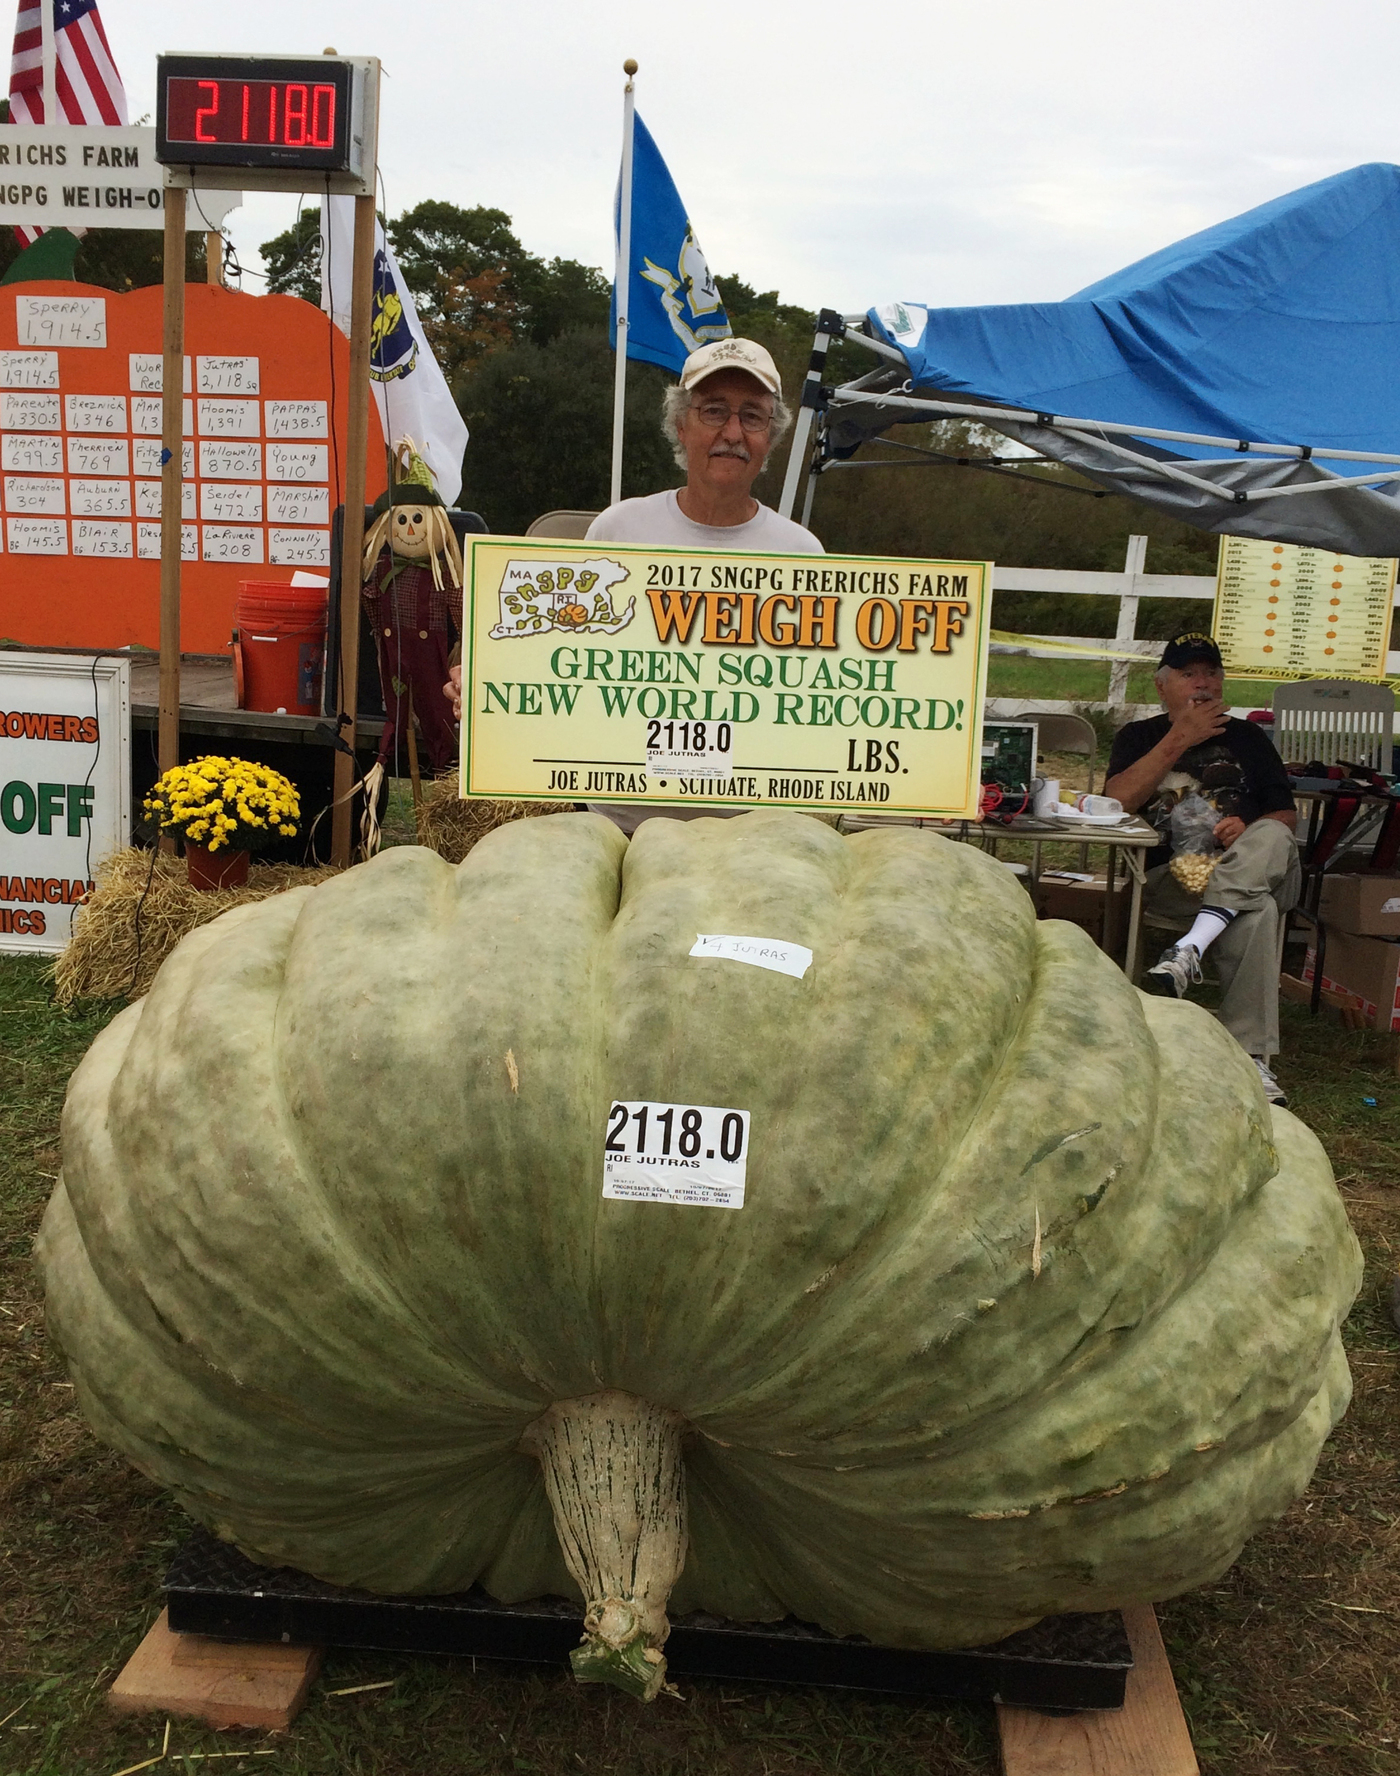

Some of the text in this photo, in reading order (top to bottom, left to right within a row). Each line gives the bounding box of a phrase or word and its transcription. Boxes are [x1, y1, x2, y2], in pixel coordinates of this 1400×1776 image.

[83, 146, 139, 167] FARM
[62, 186, 165, 209] WEIGH-O
[26, 319, 105, 344] 1,914.5
[6, 370, 58, 385] 1,914.5
[202, 373, 242, 389] 2,118
[272, 403, 317, 415] PAPPAS
[9, 412, 58, 427] 1,330.5
[73, 413, 114, 428] 1,346
[207, 418, 242, 431] 1,391
[273, 416, 325, 434] 1,438.5
[11, 450, 61, 467] 699.5
[79, 455, 111, 471] 769
[208, 460, 260, 472] 870.5
[276, 466, 306, 478] 910
[17, 496, 46, 507] 304
[84, 498, 128, 513] 365.5
[213, 504, 262, 516] 472.5
[277, 505, 308, 518] 481
[27, 537, 65, 547] 145.5
[93, 542, 131, 553] 153.5
[220, 544, 251, 556] 208
[287, 549, 330, 560] 245.5
[510, 570, 532, 580] MA
[647, 564, 968, 598] 2017 SNGPG FRERICHS FARM
[557, 595, 573, 605] RI
[645, 589, 969, 652] WEIGH OFF
[496, 625, 514, 634] CT
[550, 646, 898, 692] GREEN SQUASH
[481, 682, 965, 731] NEW WORLD RECORD!
[647, 720, 909, 774] 2118.0 LBS.
[548, 770, 579, 791] JOE
[585, 772, 648, 793] JUTRAS
[768, 778, 824, 800] RHODE
[830, 781, 890, 802] ISLAND
[1, 780, 95, 837] OFF
[0, 908, 46, 935] ICS
[605, 1105, 744, 1162] 2118.0
[605, 1154, 700, 1168] JOE JUTRAS
